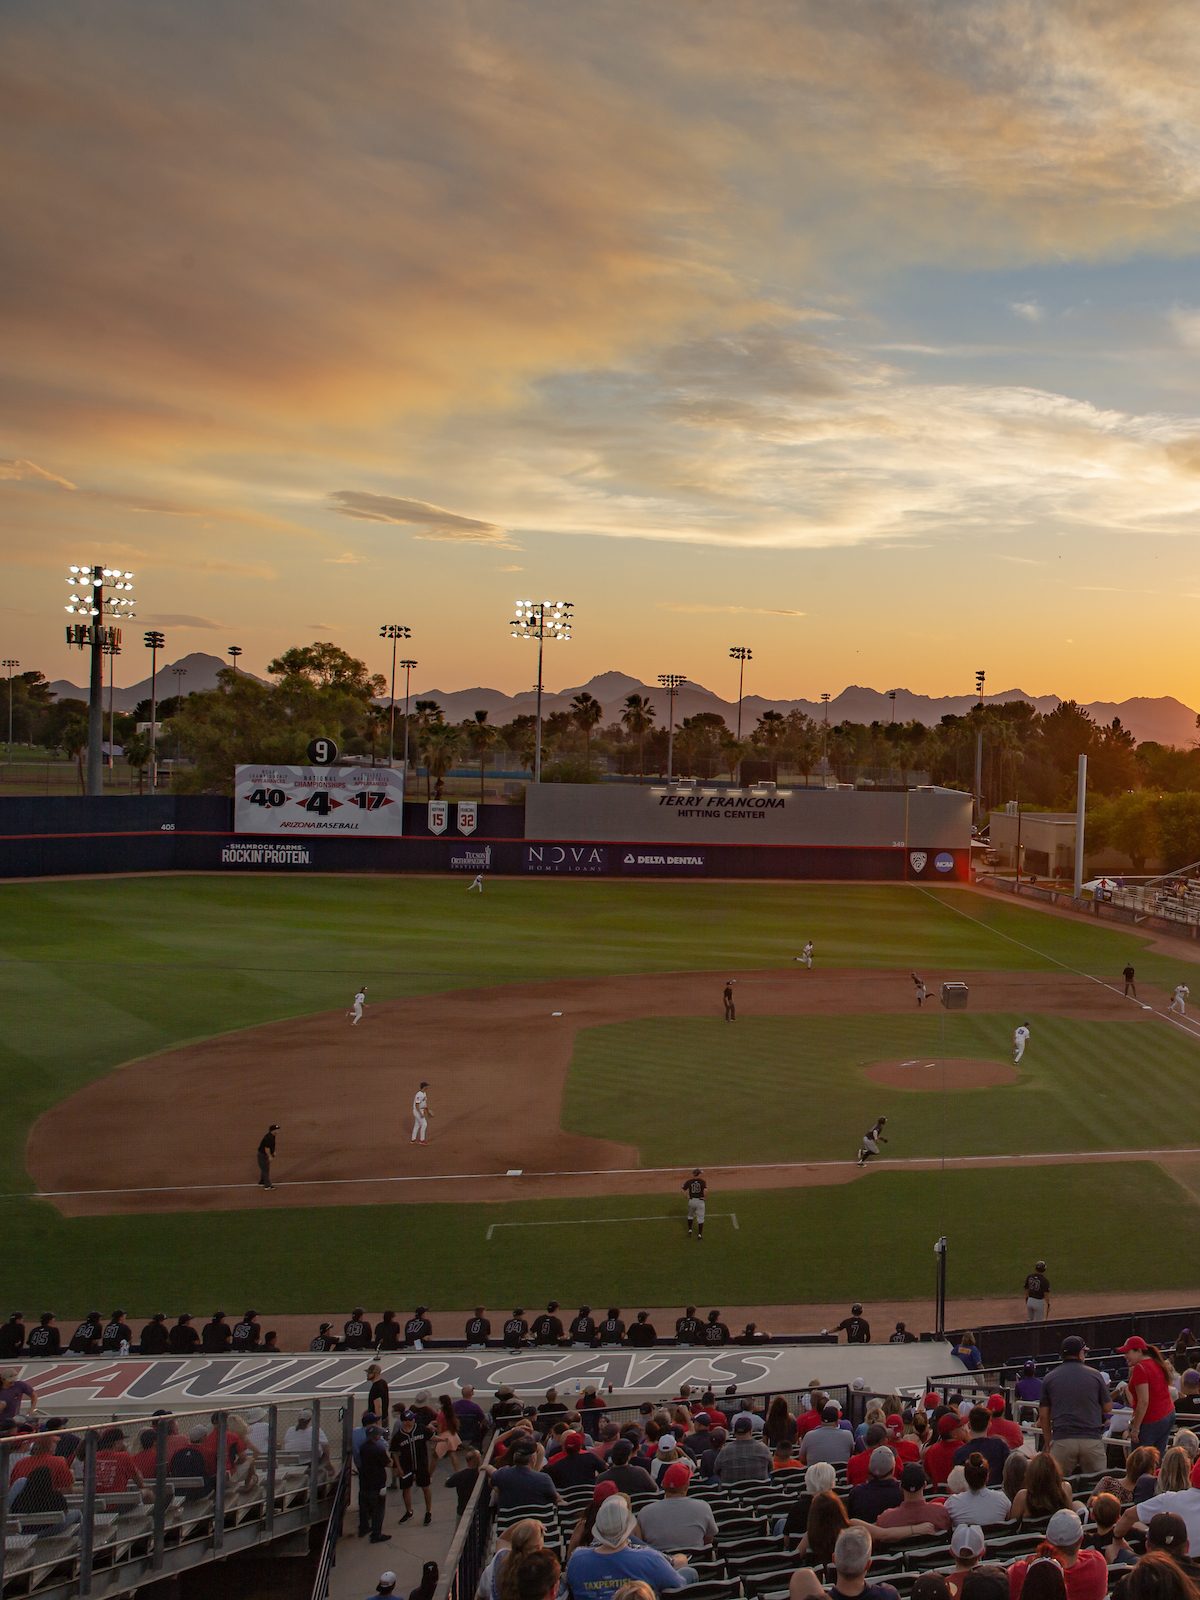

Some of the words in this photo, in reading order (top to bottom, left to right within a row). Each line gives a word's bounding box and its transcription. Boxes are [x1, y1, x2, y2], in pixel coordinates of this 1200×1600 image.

[315, 741, 329, 763] 9
[294, 780, 346, 789] CHAMPIONSHIPS
[250, 789, 286, 807] 40
[306, 791, 332, 816] 4
[355, 791, 387, 809] 17
[659, 795, 704, 807] TERRY
[707, 797, 786, 809] FRANCONA
[432, 813, 444, 826] 15
[460, 814, 474, 827] 32
[678, 809, 720, 818] HITTING
[723, 810, 765, 819] CENTER
[160, 823, 176, 831] 405
[275, 843, 303, 851] FARMS
[264, 849, 310, 864] PROTEIN
[464, 851, 486, 859] TUCSON
[527, 846, 603, 864] NOVA
[637, 855, 666, 865] DELTA
[666, 856, 703, 866] DENTAL
[568, 865, 602, 873] LOANS
[851, 1324, 860, 1336] 7
[126, 1351, 786, 1401] WILDCATS
